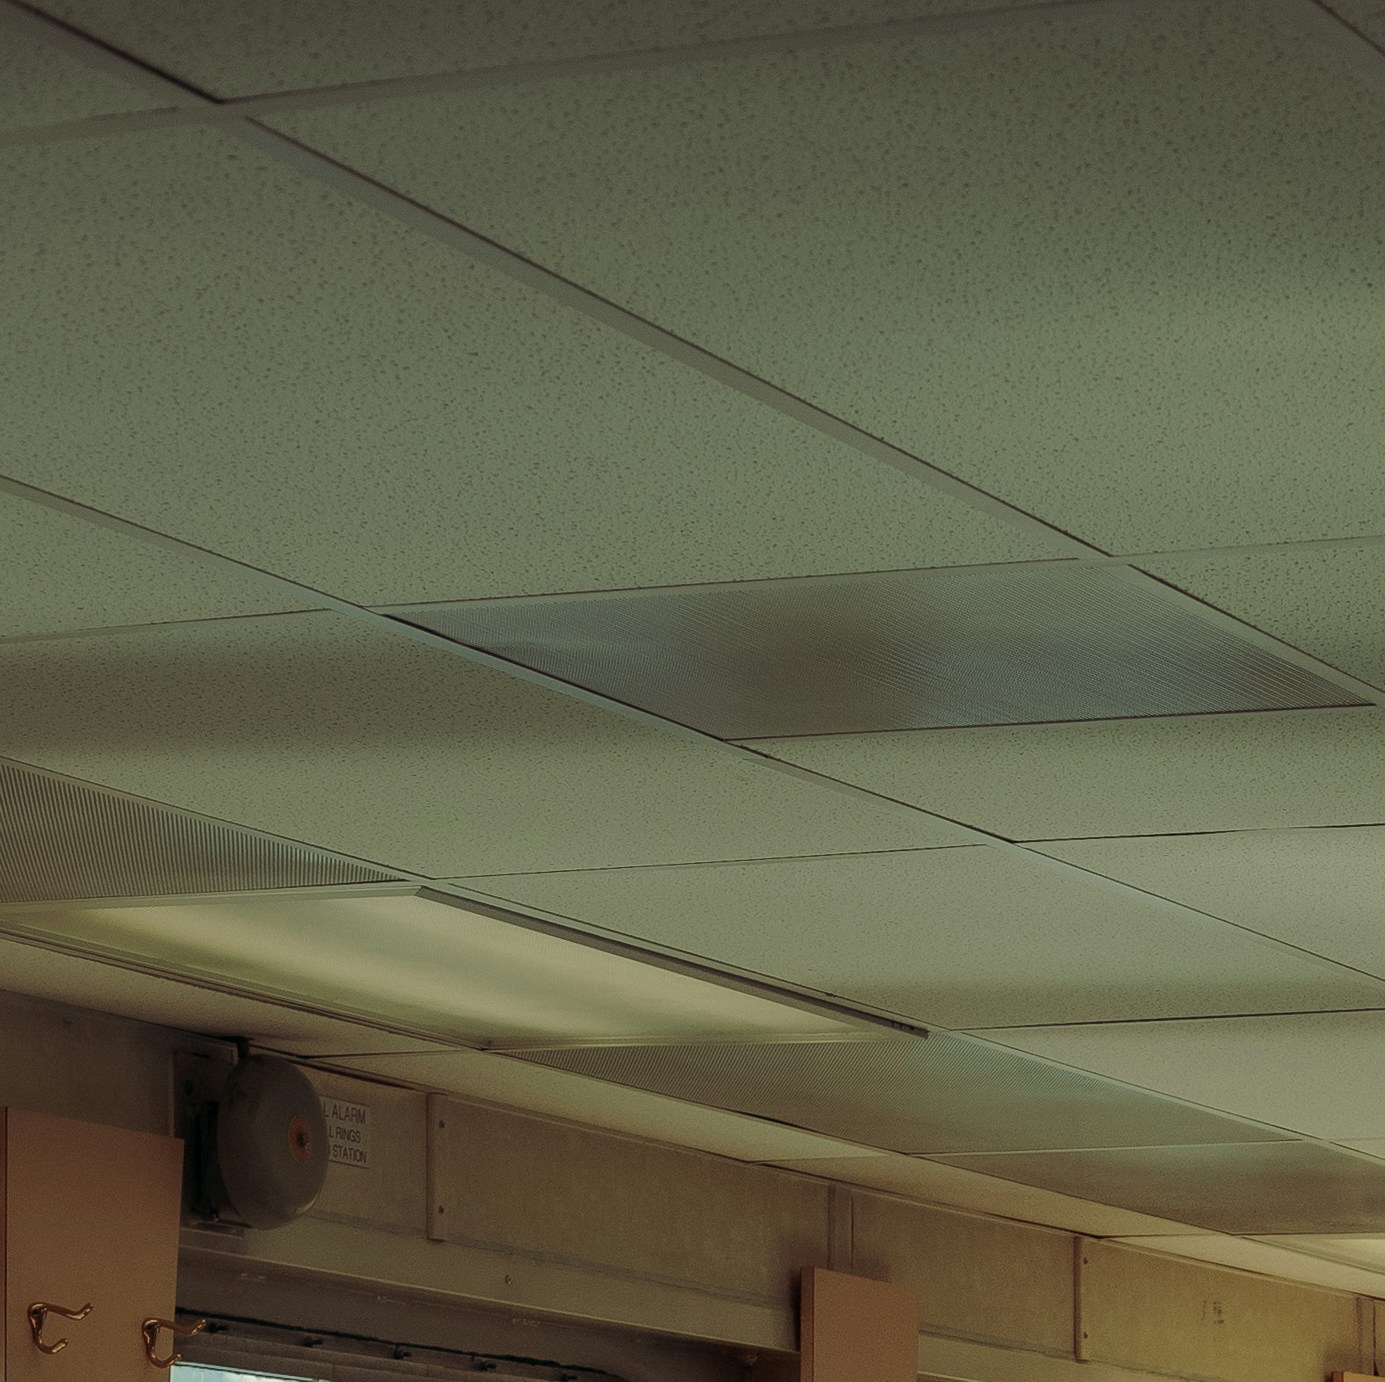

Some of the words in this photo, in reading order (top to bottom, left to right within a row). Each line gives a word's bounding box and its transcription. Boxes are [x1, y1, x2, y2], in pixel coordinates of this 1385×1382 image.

[332, 1103, 366, 1124] ALARM
[335, 1126, 361, 1143] RINGS
[332, 1144, 367, 1163] STATION
